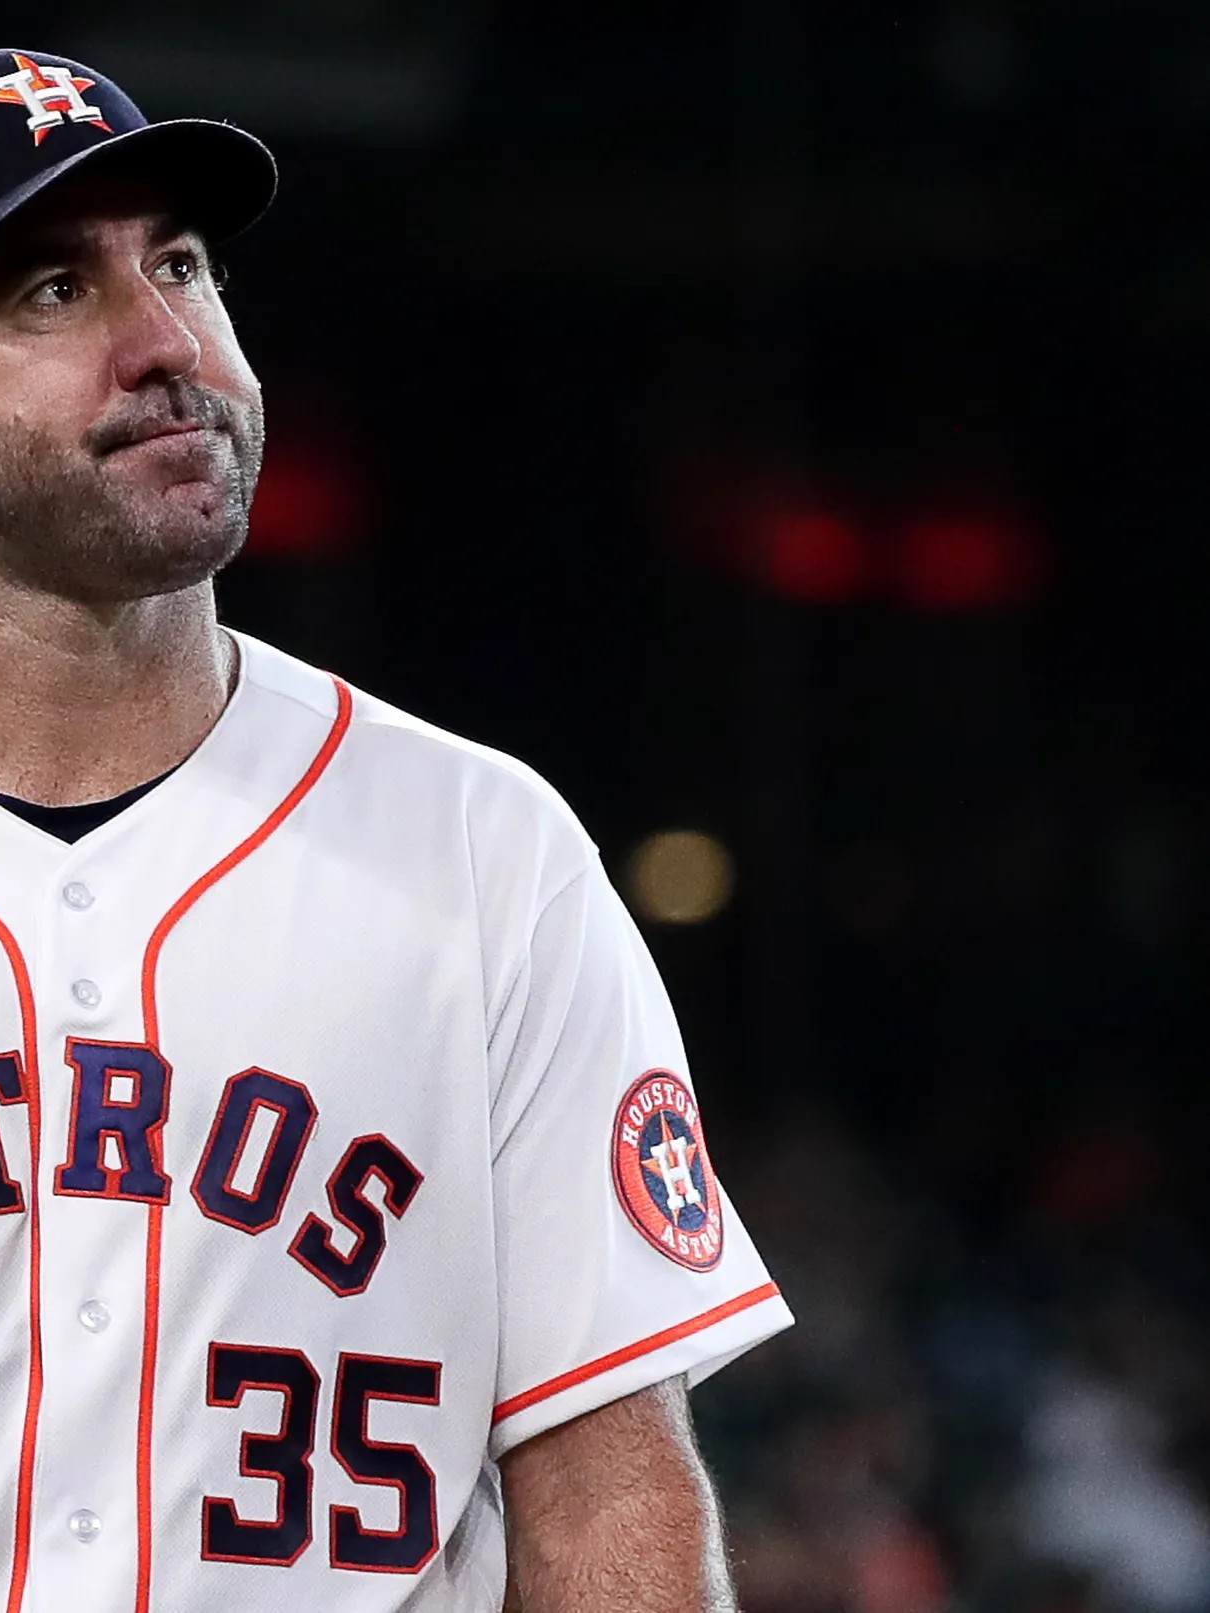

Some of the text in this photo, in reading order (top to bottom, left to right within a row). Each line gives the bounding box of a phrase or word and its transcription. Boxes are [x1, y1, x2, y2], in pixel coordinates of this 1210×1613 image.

[622, 1082, 699, 1149] HOUSTON
[661, 1208, 722, 1259] ASTROS
[201, 1341, 442, 1574] 35
